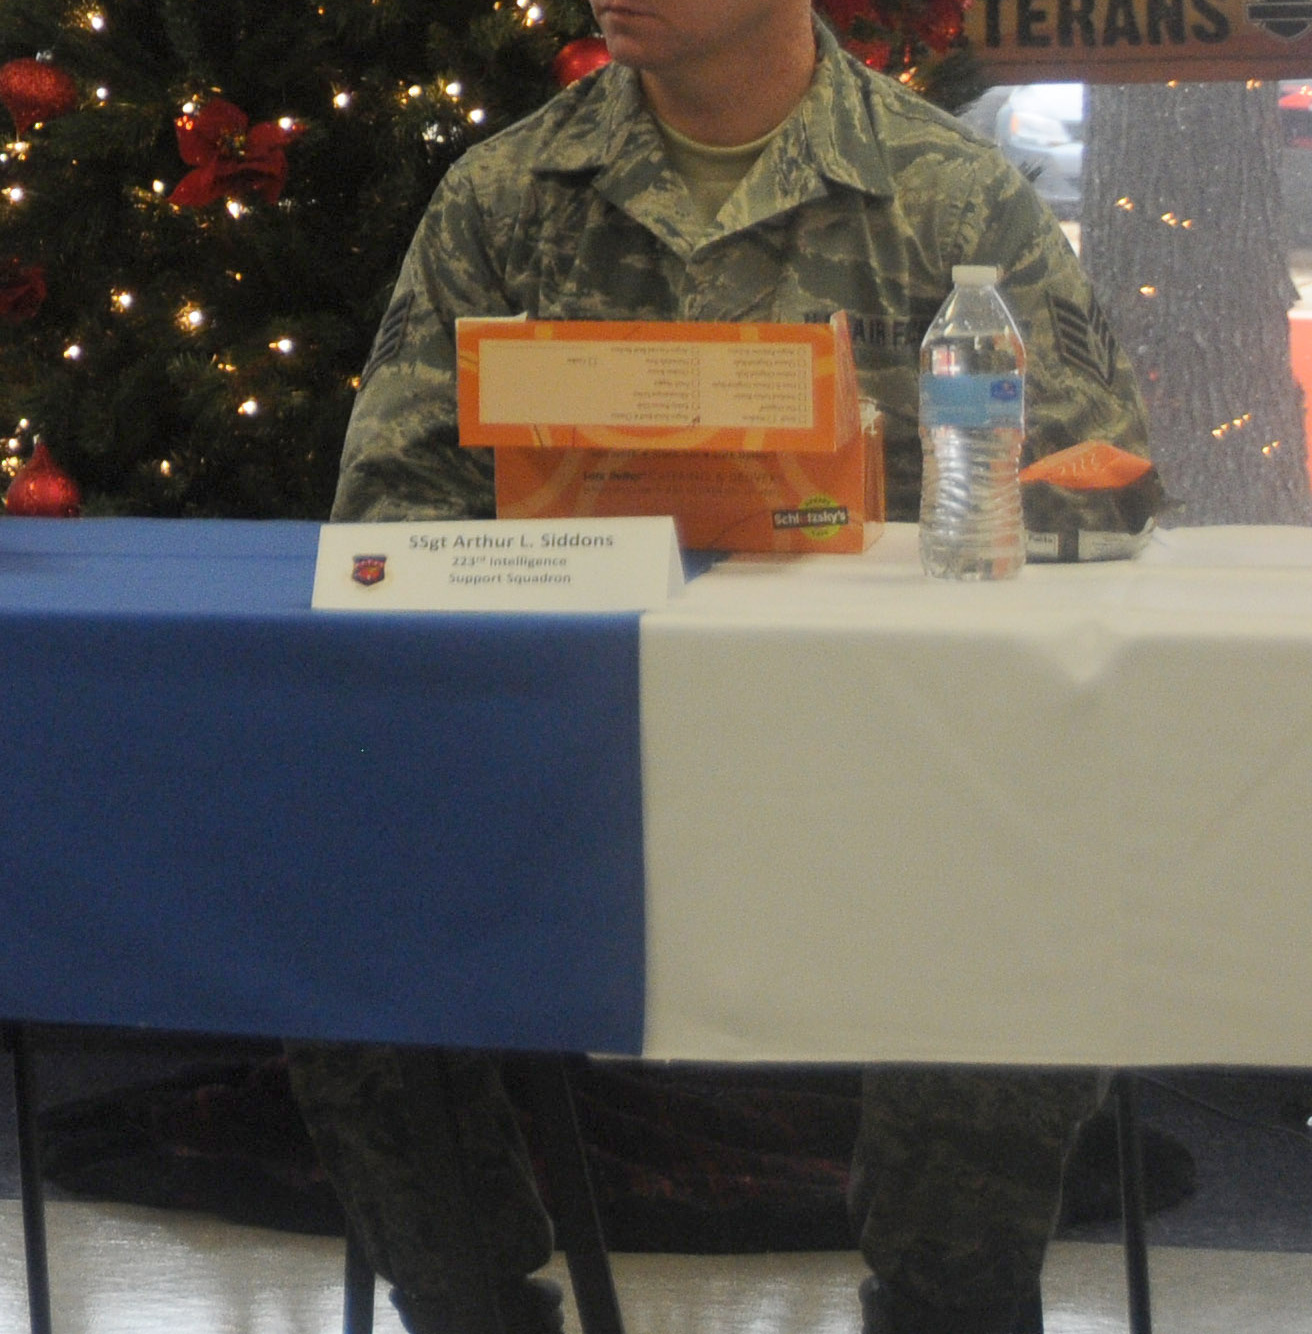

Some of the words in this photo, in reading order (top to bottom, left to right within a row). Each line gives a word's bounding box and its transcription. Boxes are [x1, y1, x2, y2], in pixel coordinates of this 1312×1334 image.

[409, 534, 448, 551] SSgt
[453, 533, 514, 549] Arthur
[520, 534, 534, 548] L.
[541, 532, 614, 548] Siddons
[489, 554, 568, 570] Intelligence
[448, 572, 502, 586] Support
[506, 572, 572, 586] Squadron
